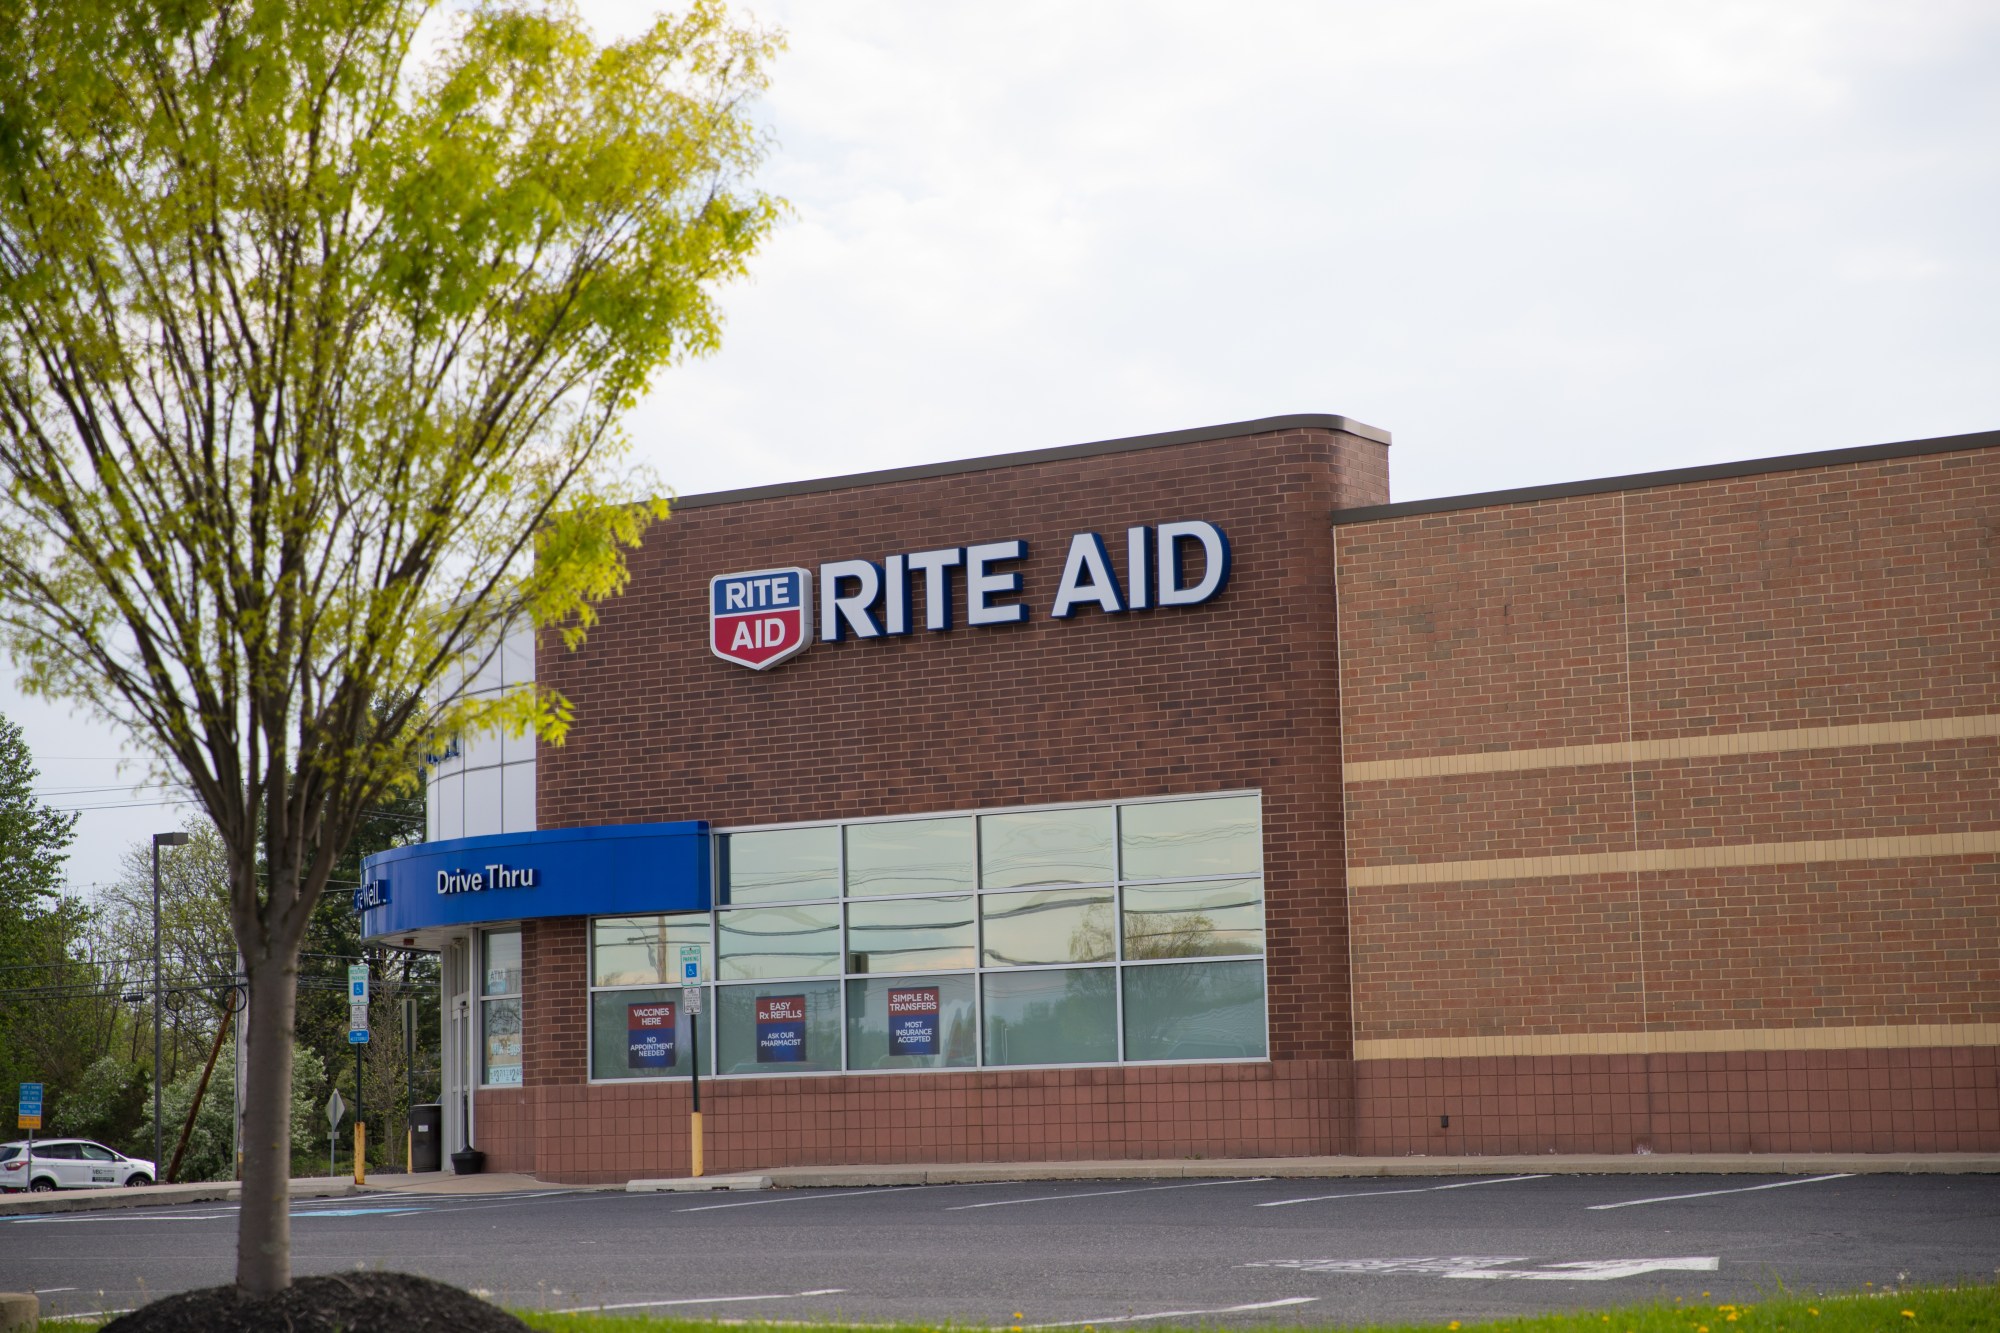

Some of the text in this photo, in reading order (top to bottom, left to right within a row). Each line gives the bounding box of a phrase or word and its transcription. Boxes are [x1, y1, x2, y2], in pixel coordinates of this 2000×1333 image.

[820, 520, 1231, 642] RITE AID
[726, 577, 790, 610] RITE
[731, 618, 786, 651] AID
[437, 864, 533, 894] Drive Thru
[892, 993, 934, 1003] SIMPLE Rx
[770, 1002, 791, 1011] EASY
[890, 1002, 937, 1011] TRANSFERS
[633, 1008, 670, 1017] VACCINES
[759, 1010, 802, 1020] Rx REFILLS
[641, 1017, 662, 1026] HERE
[780, 1031, 795, 1039] OUR
[895, 1028, 932, 1036] INSURANCE
[646, 1036, 657, 1044] NO
[760, 1039, 802, 1047] PHARMACIST
[897, 1035, 931, 1043] ACCEPTED
[630, 1042, 674, 1051] APPOINTMENT
